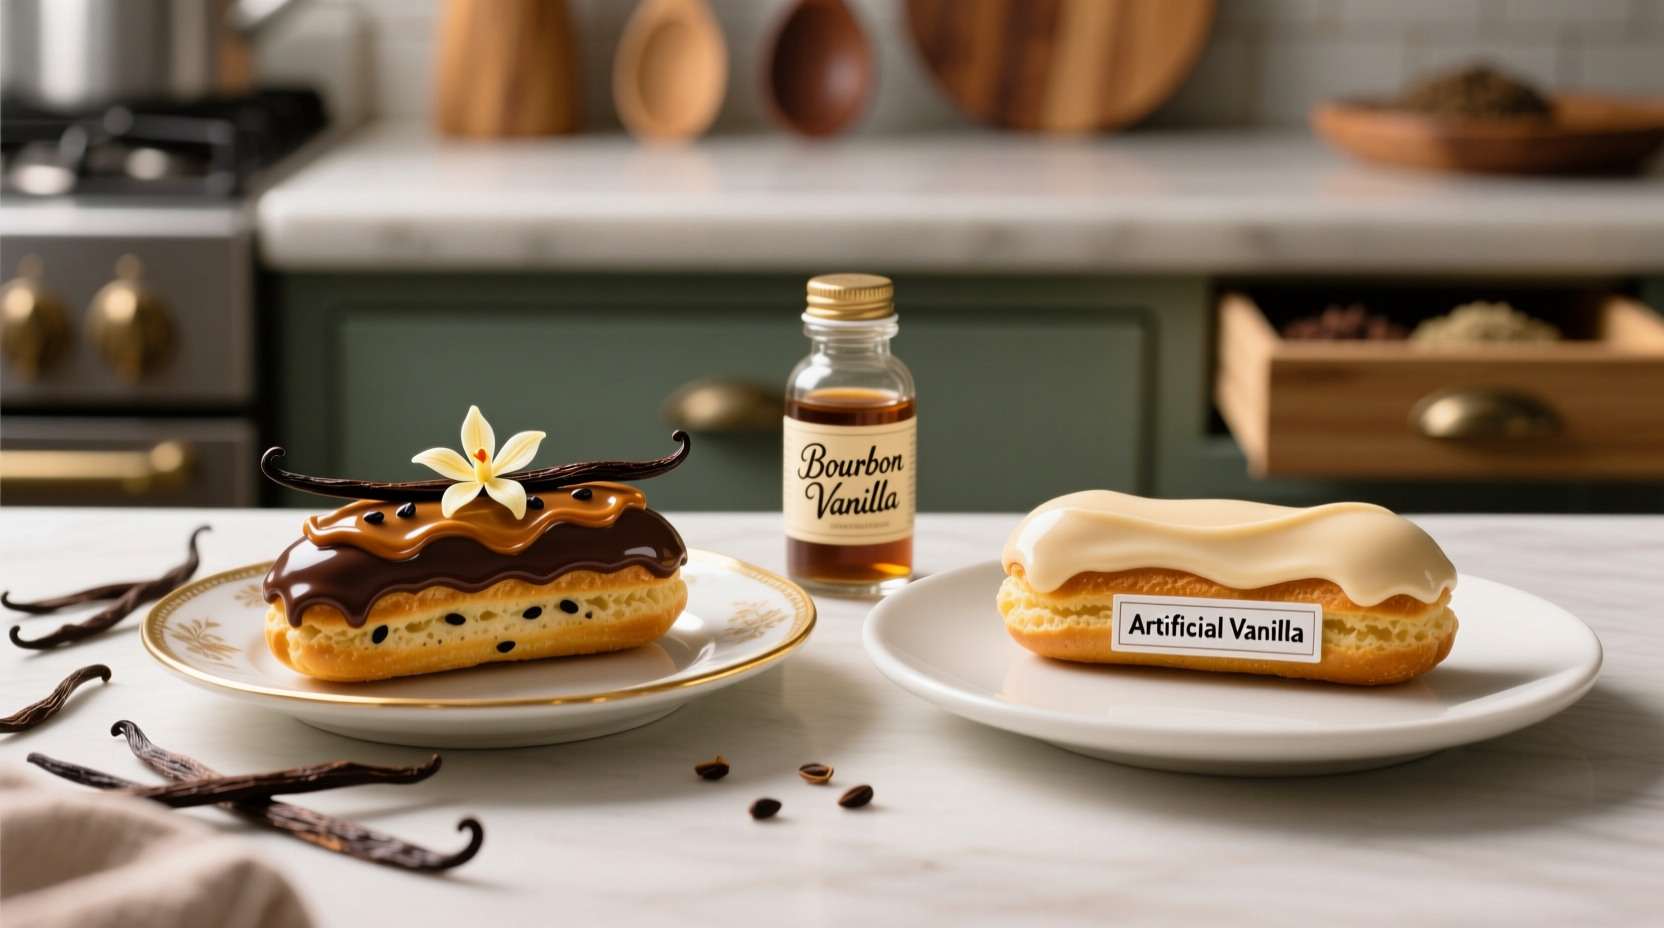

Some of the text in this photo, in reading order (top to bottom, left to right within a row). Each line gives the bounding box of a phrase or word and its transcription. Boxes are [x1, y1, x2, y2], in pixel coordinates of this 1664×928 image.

[798, 443, 904, 480] Bourbon
[805, 479, 900, 520] Vanilla
[1128, 613, 1304, 643] Artificial Vanilla
